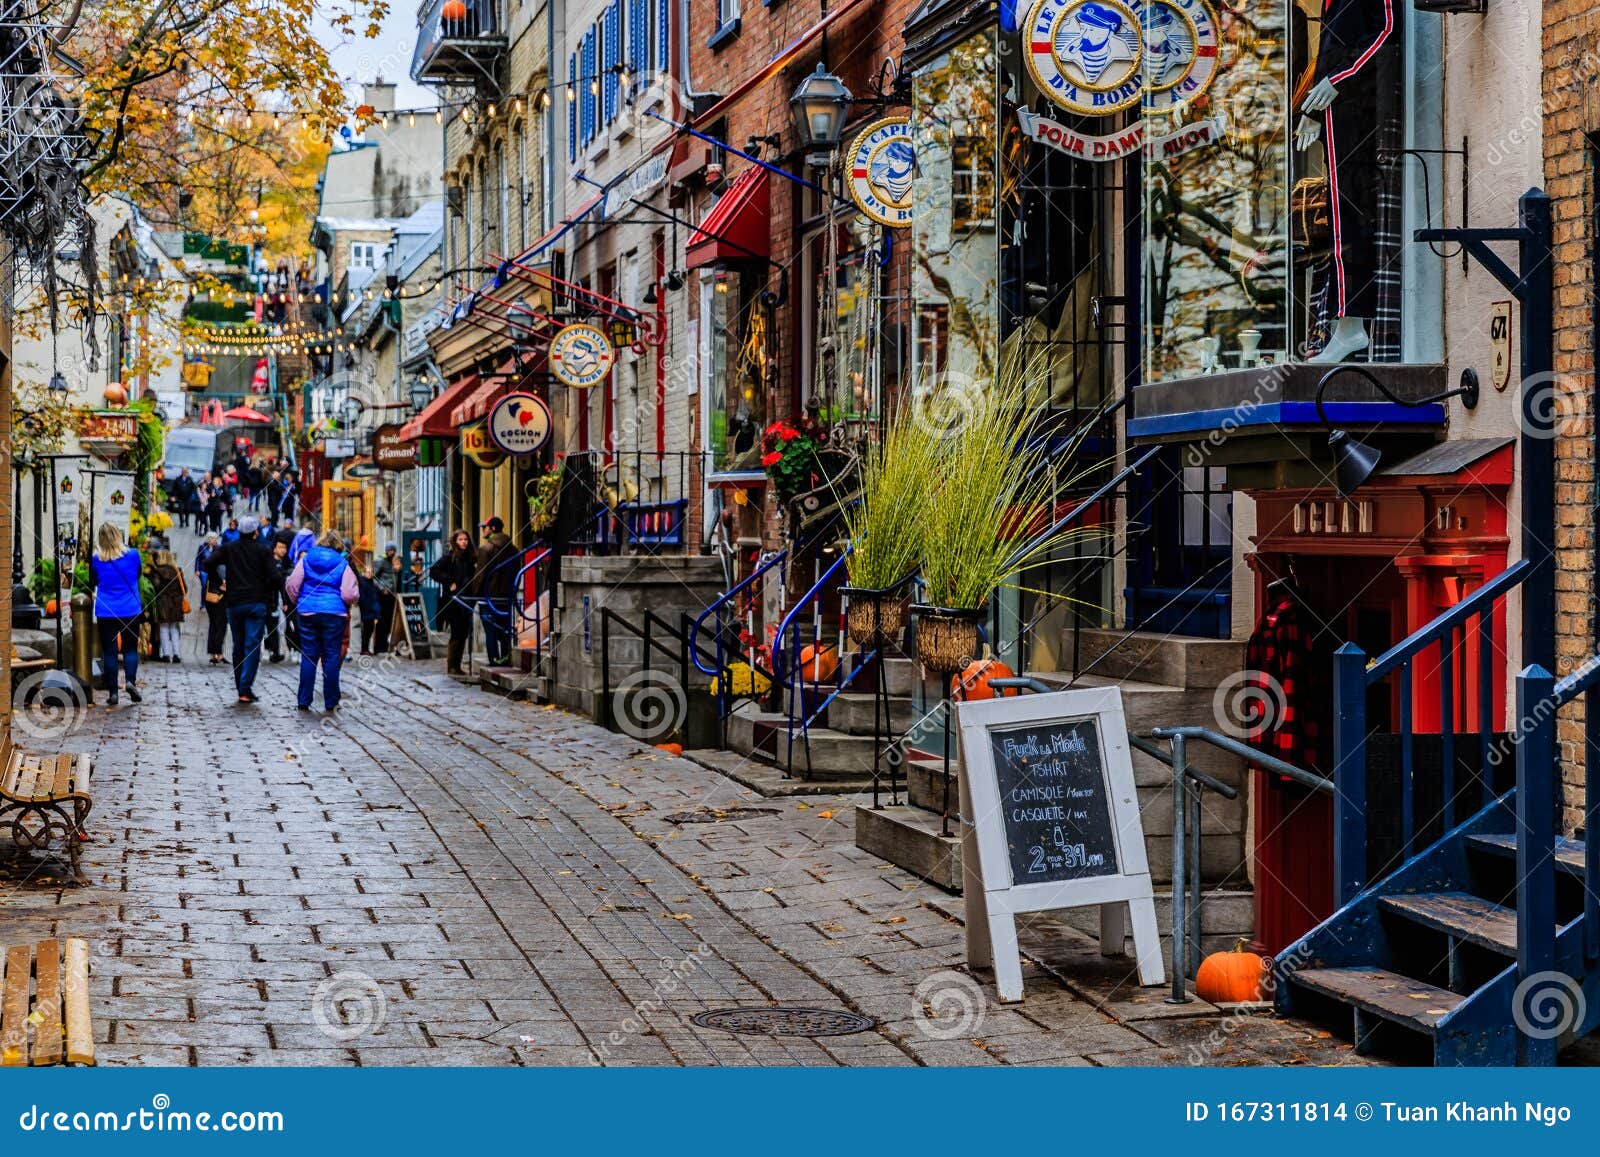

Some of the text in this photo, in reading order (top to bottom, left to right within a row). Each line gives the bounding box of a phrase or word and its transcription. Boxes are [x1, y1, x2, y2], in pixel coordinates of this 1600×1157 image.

[1037, 122, 1086, 156] POUR
[500, 428, 541, 438] COCHON
[1293, 501, 1373, 534] OCLAN
[1028, 845, 1047, 874] 2
